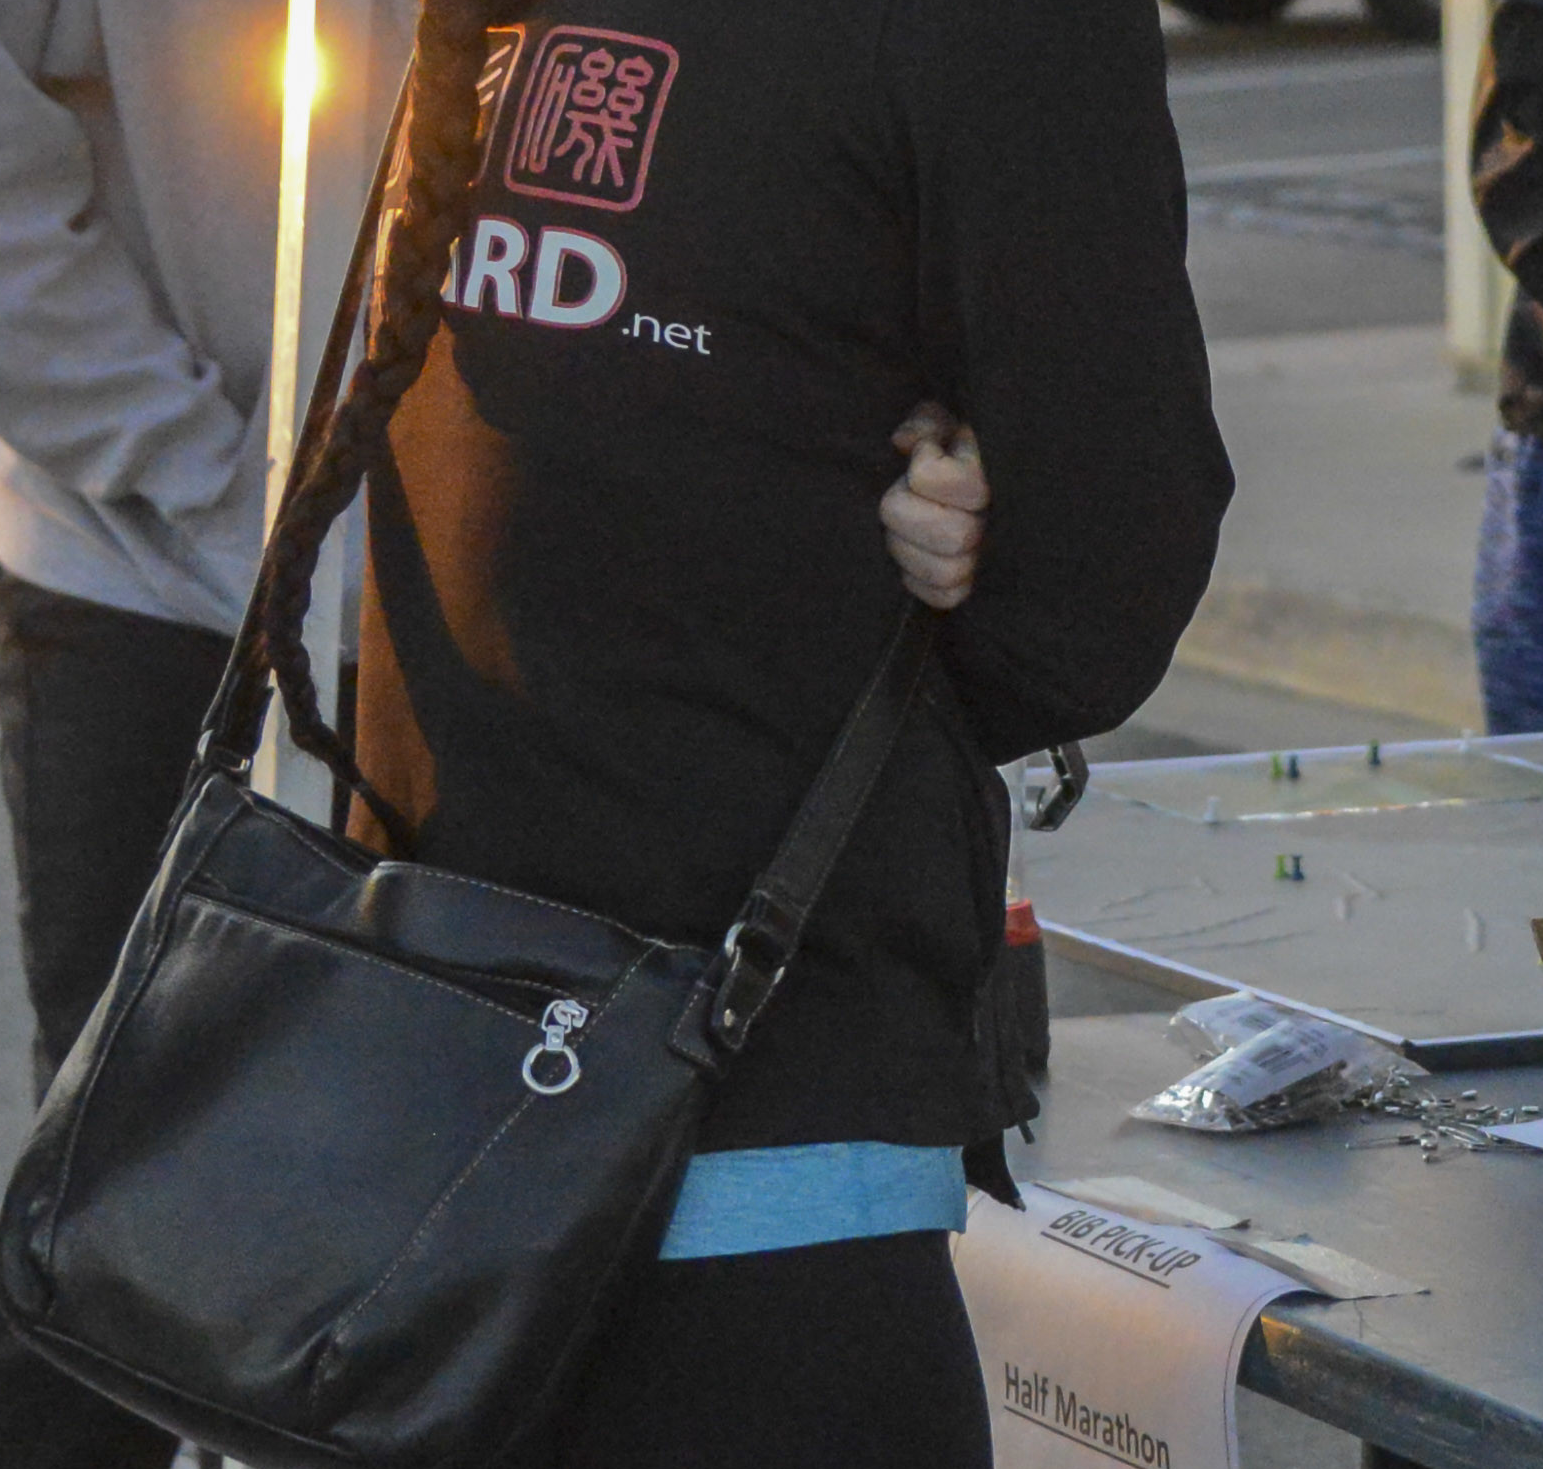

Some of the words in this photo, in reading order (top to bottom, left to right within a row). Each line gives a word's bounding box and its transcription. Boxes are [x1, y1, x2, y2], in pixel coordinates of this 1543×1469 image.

[1049, 1210, 1108, 1239] BIB
[1090, 1225, 1202, 1276] PICK-UP
[1005, 1361, 1049, 1416] Half
